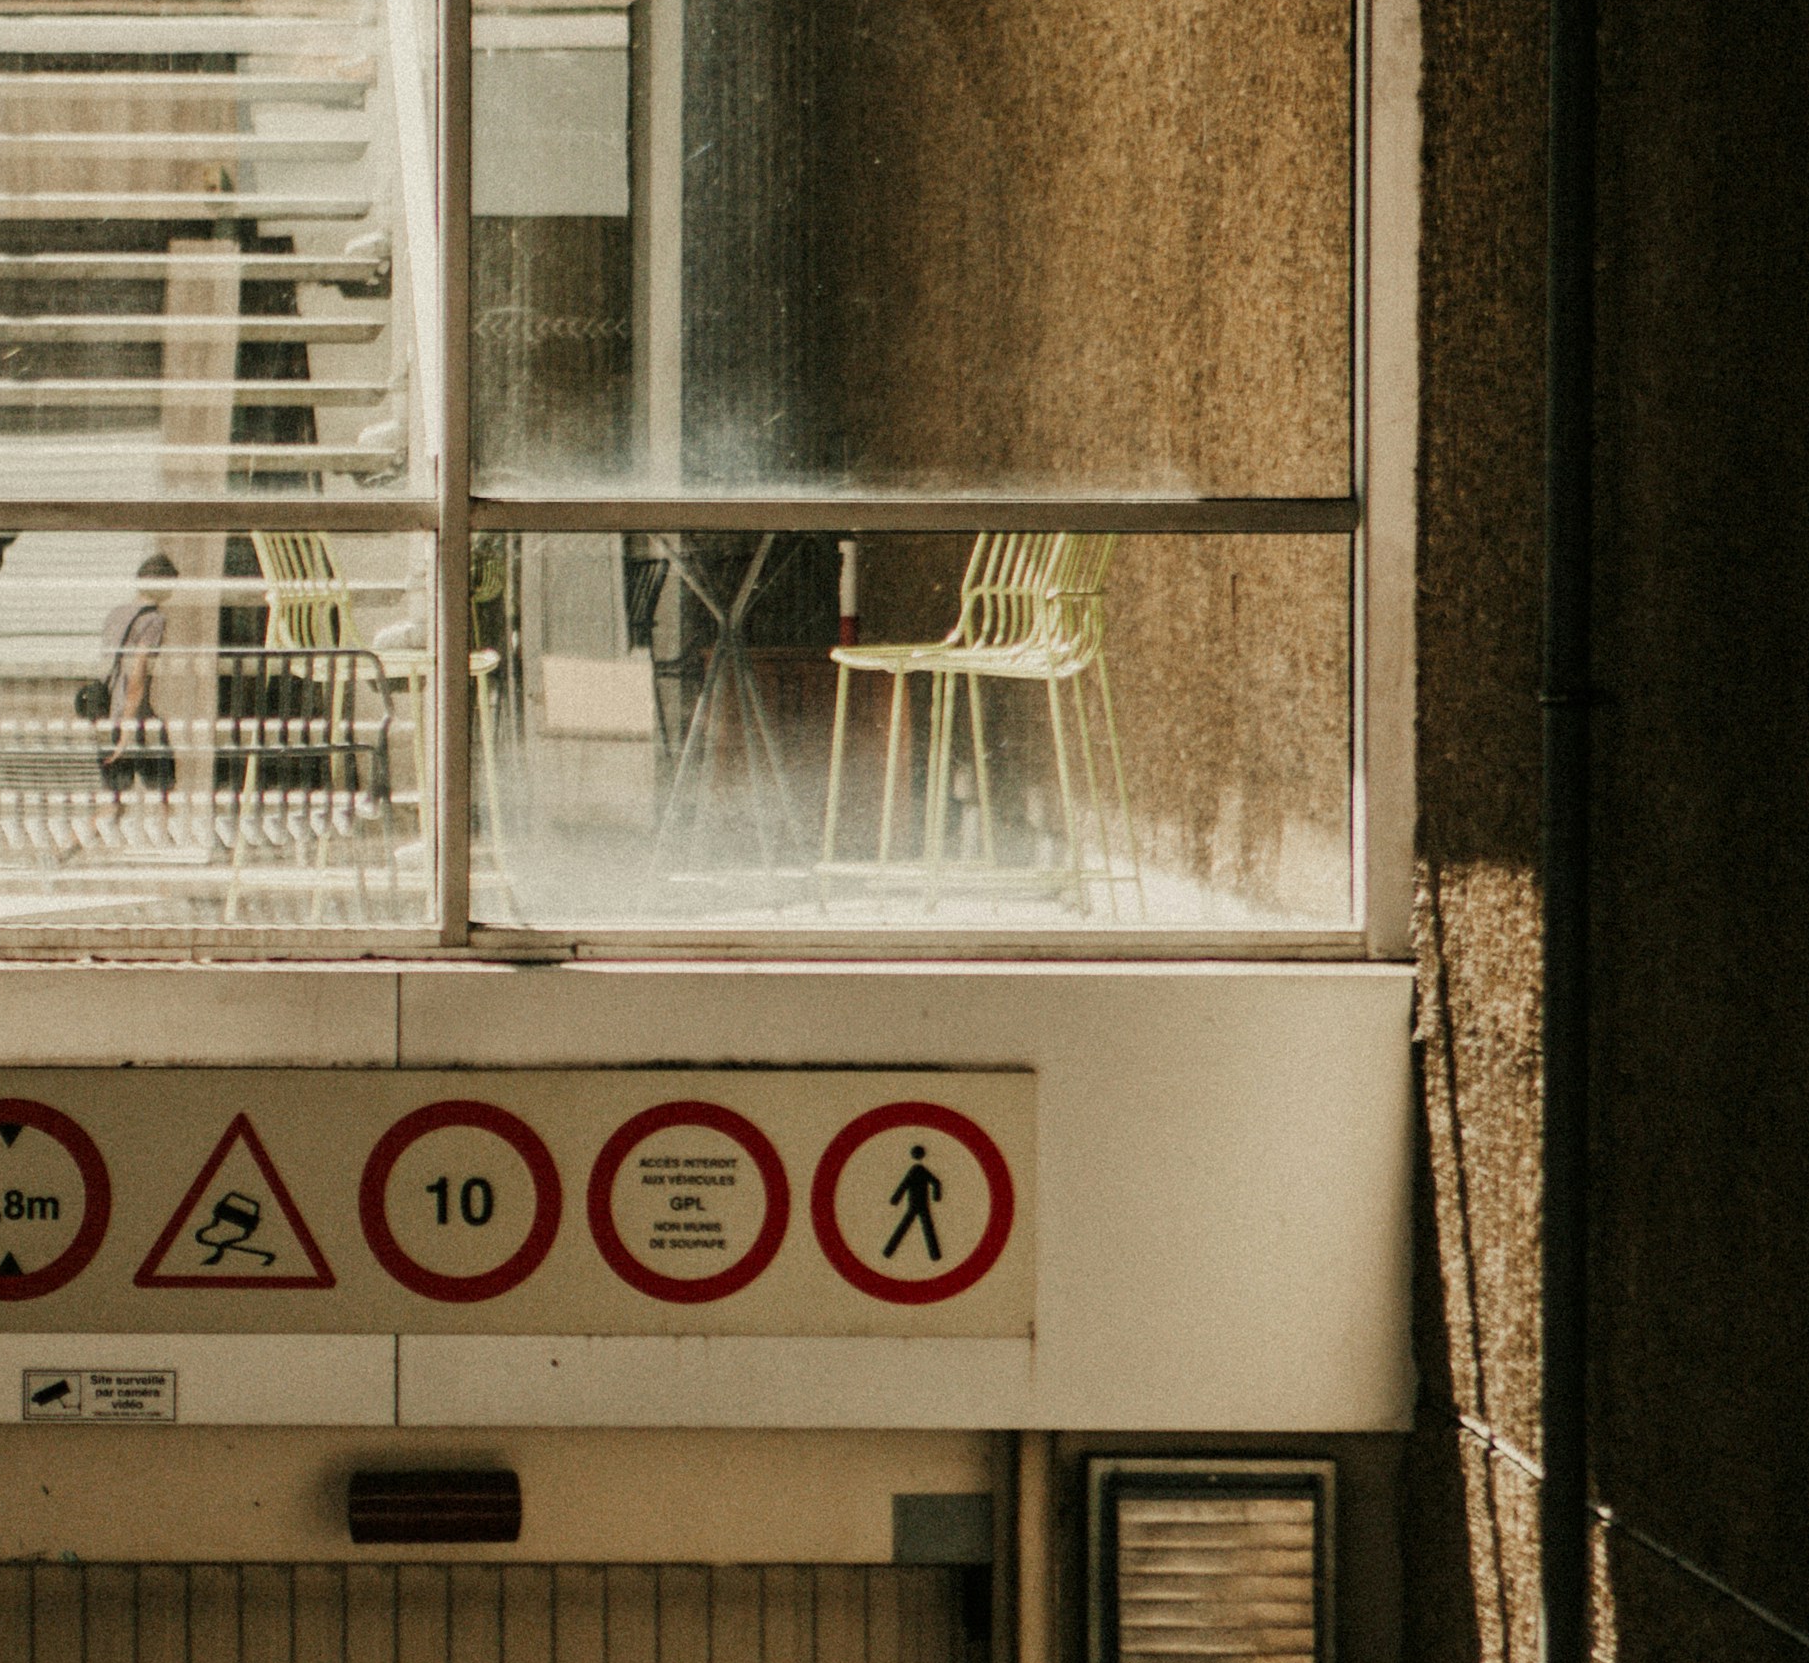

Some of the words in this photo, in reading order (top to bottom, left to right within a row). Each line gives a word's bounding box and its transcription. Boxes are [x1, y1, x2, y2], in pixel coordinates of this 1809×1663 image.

[683, 1158, 737, 1168] INTERDIT
[642, 1175, 665, 1186] AUX
[425, 1176, 493, 1227] 10
[670, 1196, 706, 1211] GPL
[90, 1374, 113, 1385] Site
[116, 1374, 165, 1385] surveillé
[95, 1389, 114, 1399] par
[117, 1388, 161, 1398] caméra
[111, 1399, 144, 1410] vidéo
